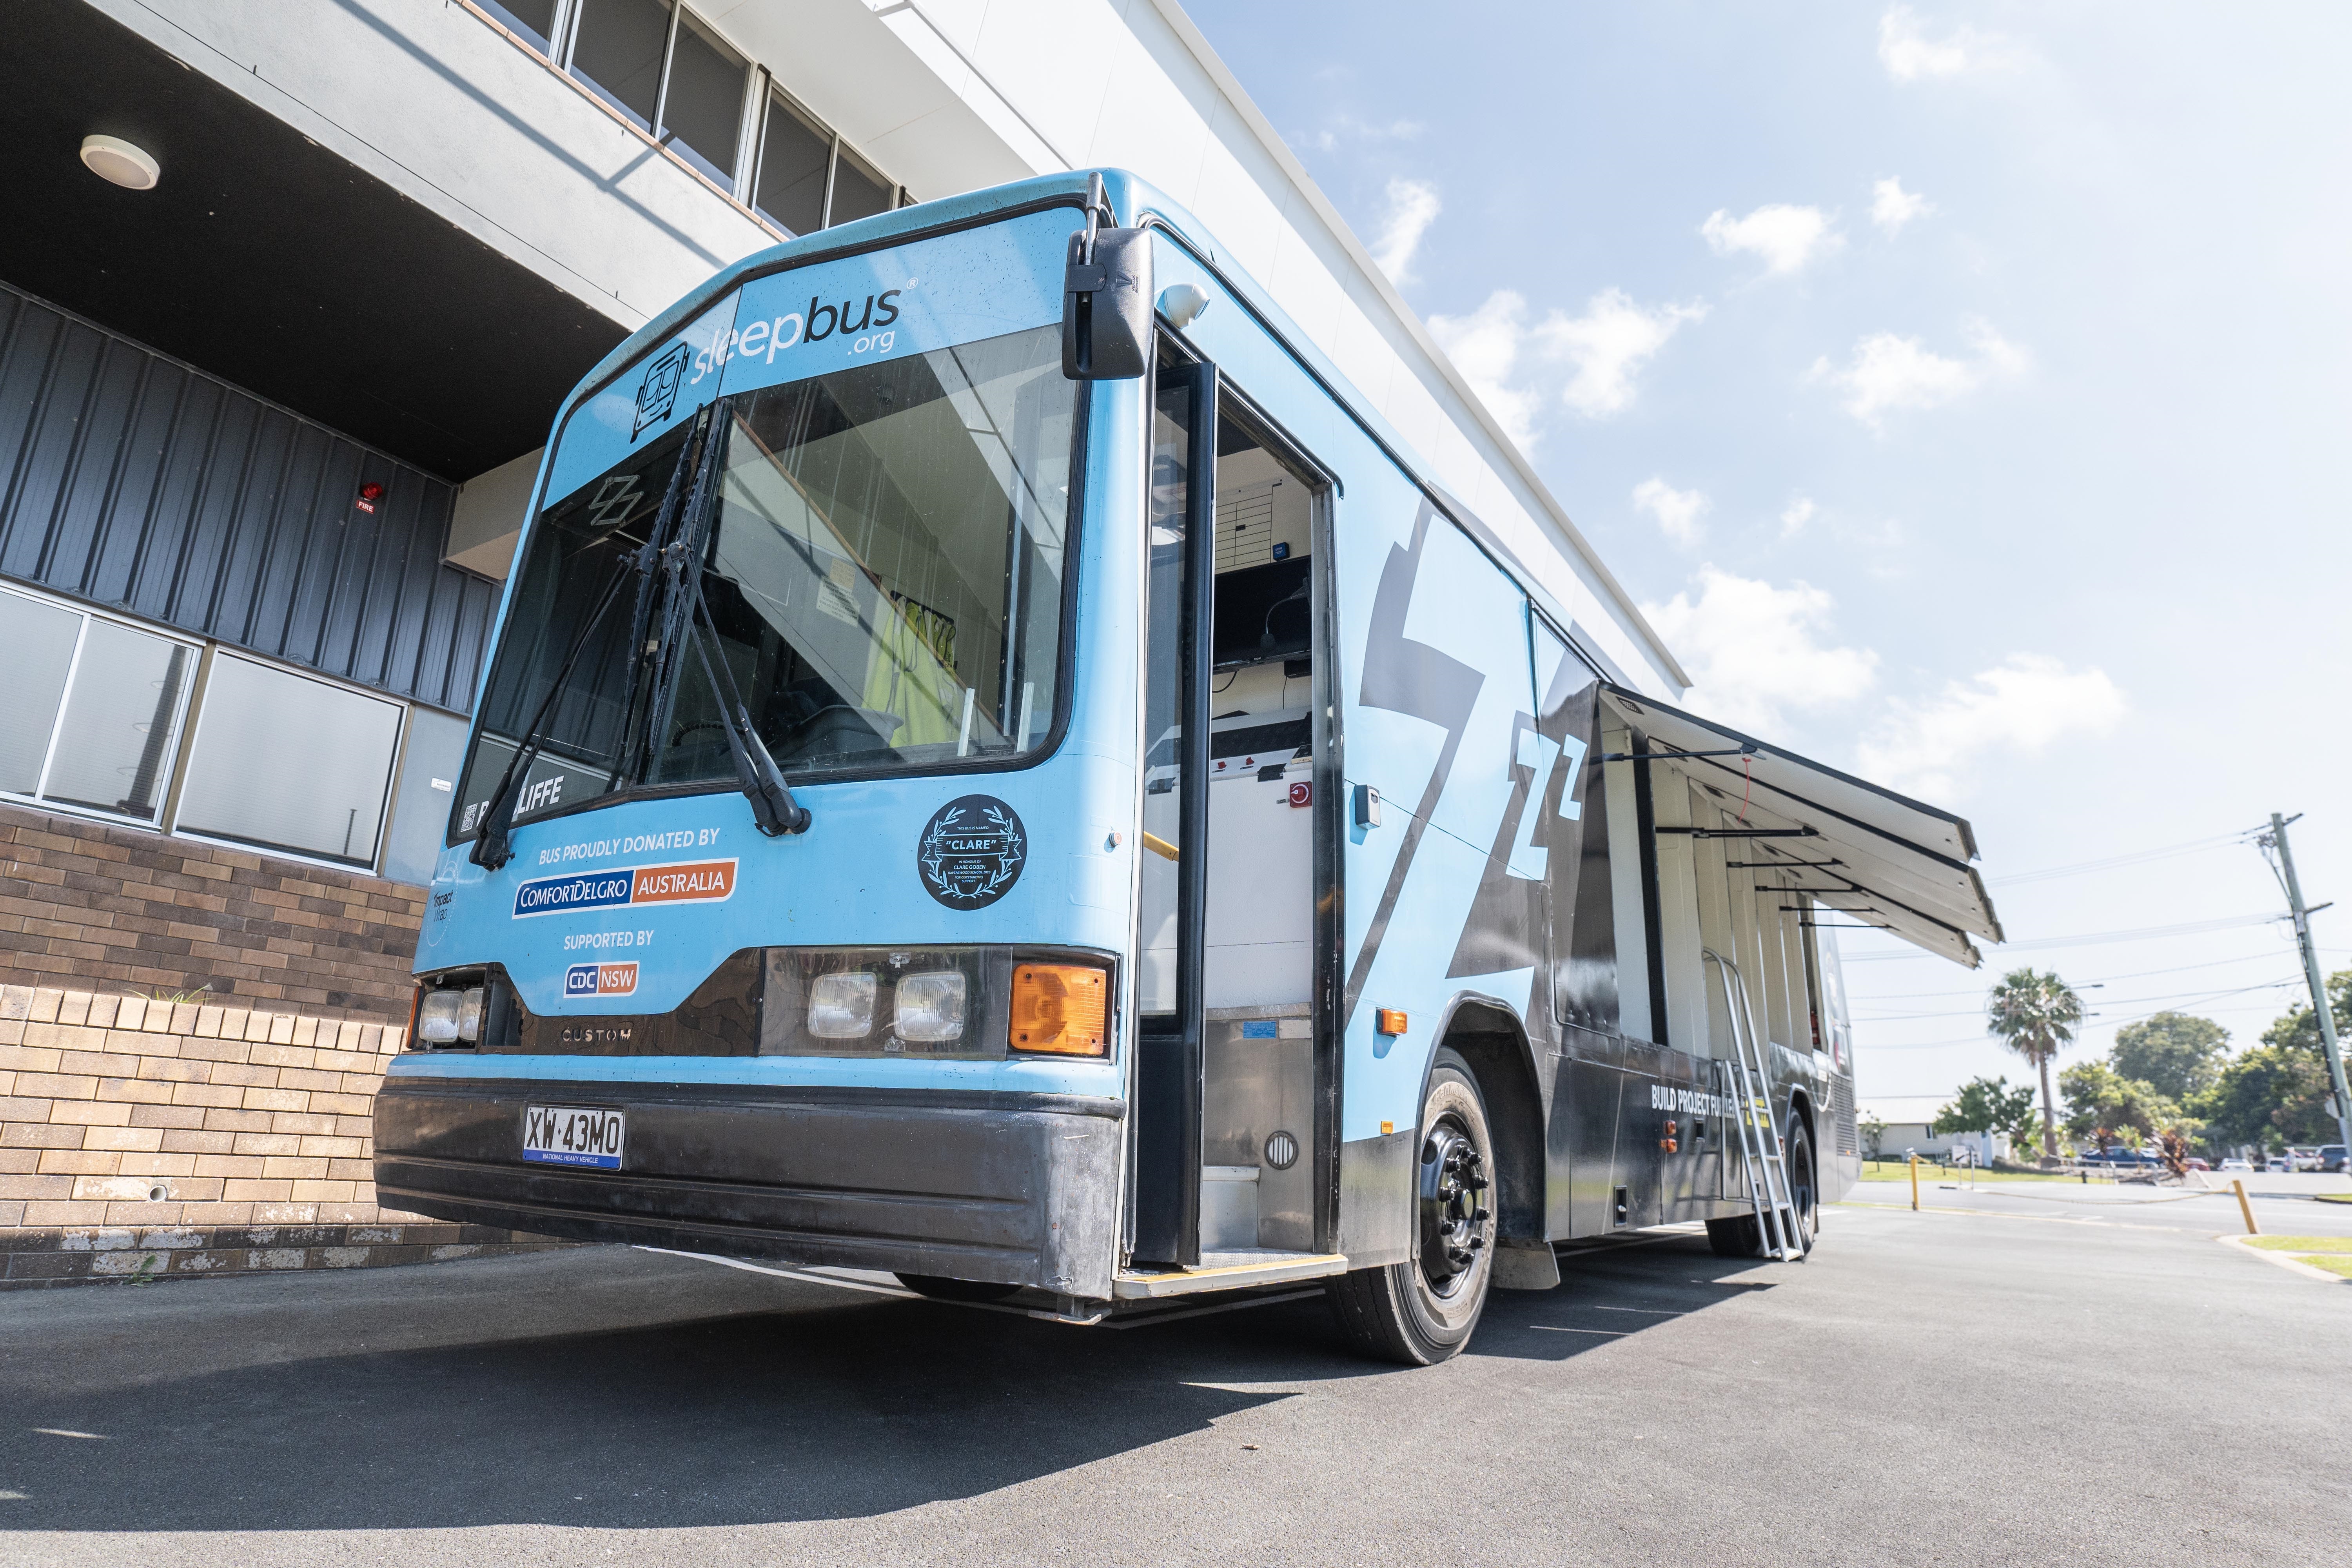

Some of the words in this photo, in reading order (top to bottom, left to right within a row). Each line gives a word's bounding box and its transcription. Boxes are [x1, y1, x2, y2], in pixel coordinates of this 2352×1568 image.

[358, 501, 374, 512] FIRE
[539, 847, 561, 865] BUS
[563, 838, 622, 861] PROUDLY
[624, 831, 695, 853] DONATED
[699, 828, 720, 846] BY
[638, 871, 724, 895] AUSTRALIA
[434, 908, 448, 924] Wrap
[564, 931, 633, 950] SUPPORTED
[637, 930, 654, 946] BY
[569, 971, 596, 990] CDC
[601, 969, 634, 987] NSW
[561, 1028, 632, 1042] CUSTOM
[1651, 1084, 1677, 1111] BUILD
[1678, 1089, 1710, 1116] PROJECT
